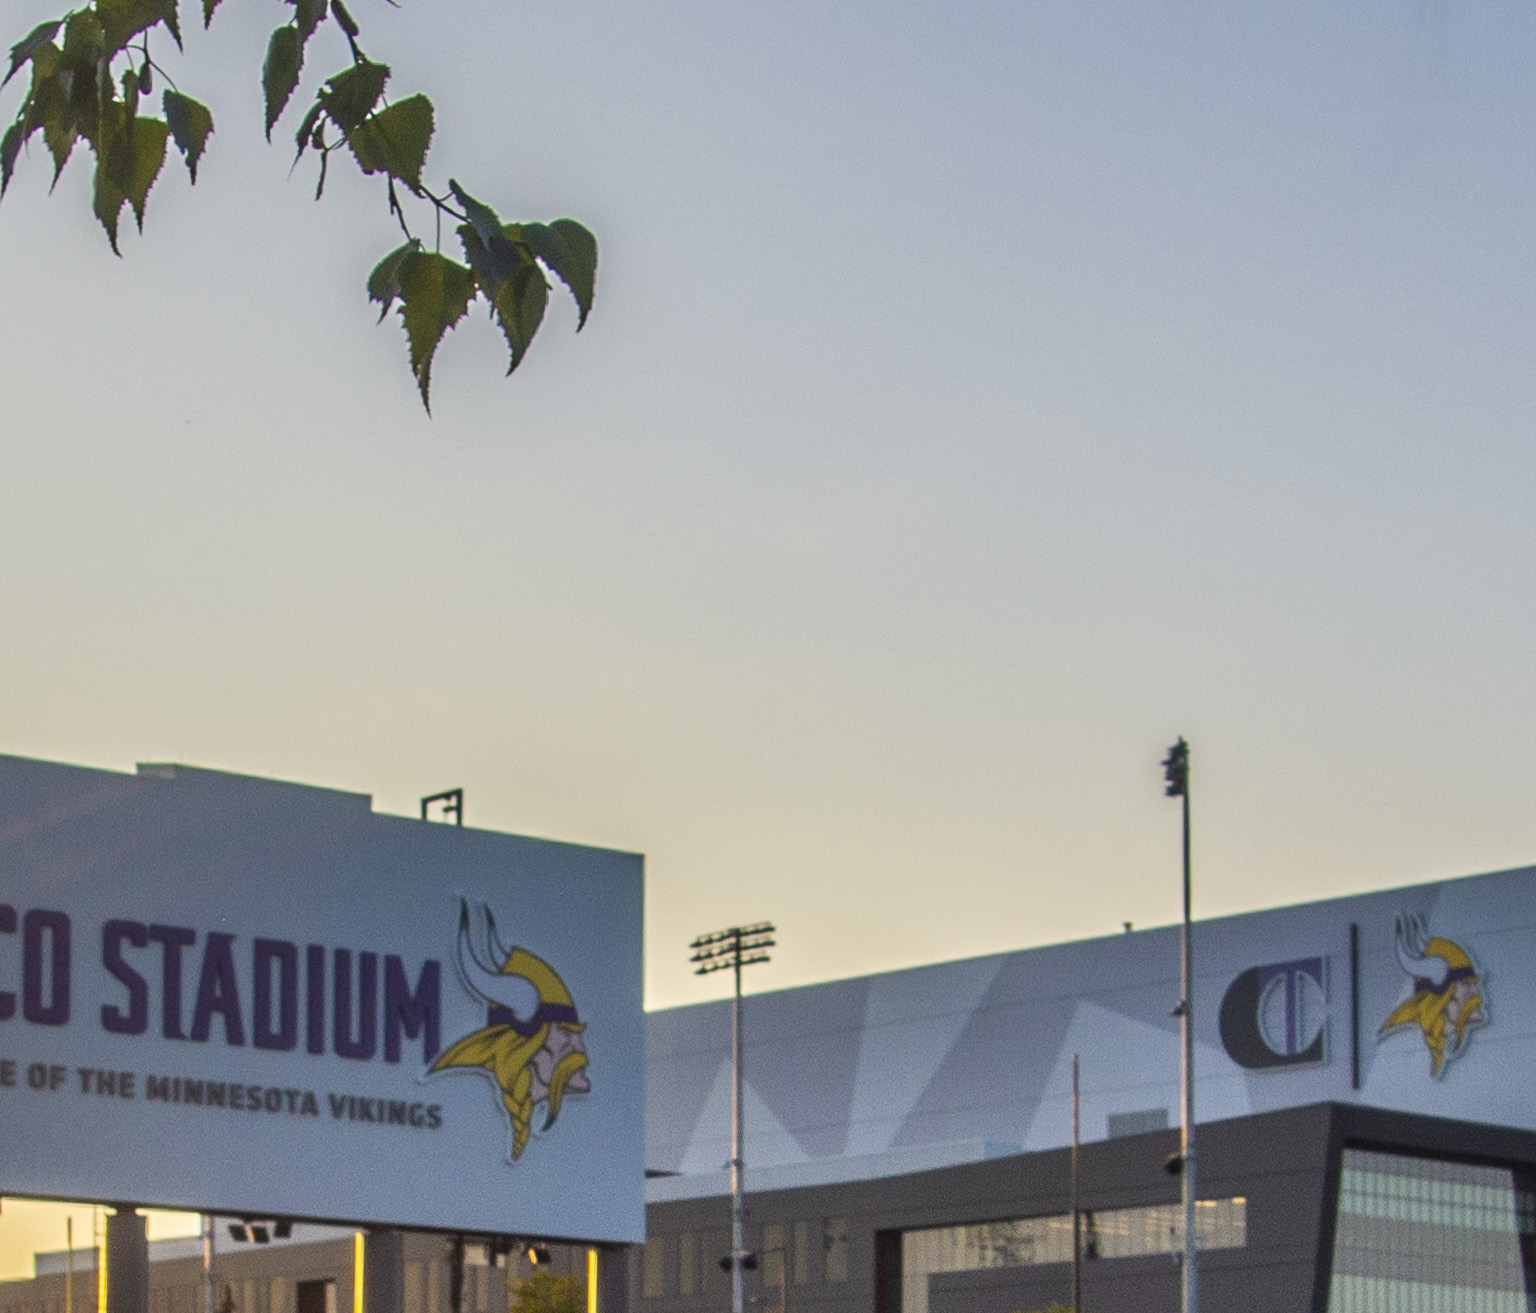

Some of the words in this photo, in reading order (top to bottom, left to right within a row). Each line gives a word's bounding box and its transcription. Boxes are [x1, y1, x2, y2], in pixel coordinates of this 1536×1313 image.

[100, 918, 442, 1065] STADIUM
[26, 1062, 67, 1092] OF
[76, 1066, 135, 1100] THE
[145, 1073, 320, 1118] MINNESOTA
[327, 1092, 443, 1130] VIKINGS
